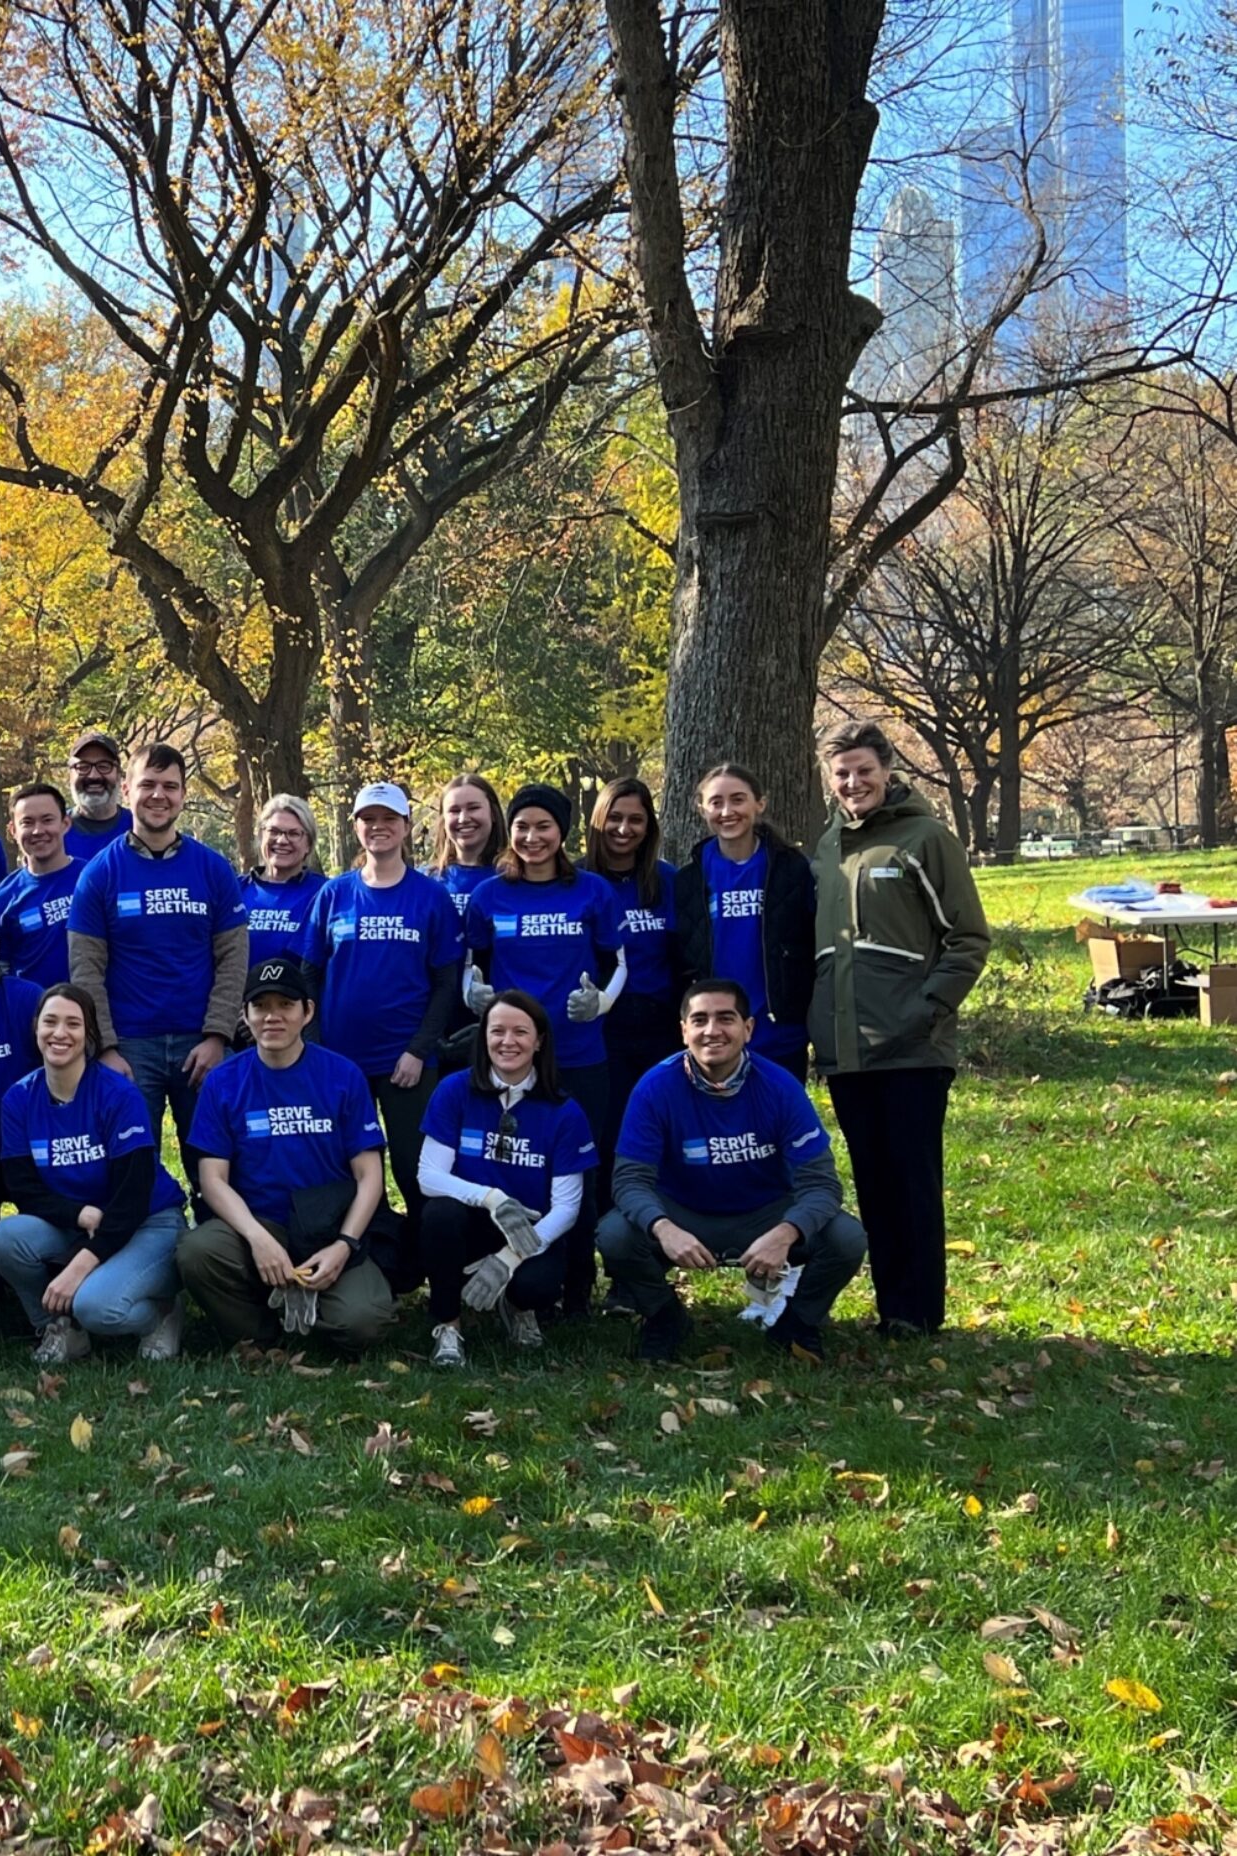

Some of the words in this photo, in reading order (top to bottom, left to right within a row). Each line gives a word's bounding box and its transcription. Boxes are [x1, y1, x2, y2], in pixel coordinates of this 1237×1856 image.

[145, 888, 189, 901] SERVE
[722, 889, 764, 904] SERVE
[43, 895, 73, 914] SERV
[146, 901, 207, 915] 2GETHER
[249, 909, 290, 921] SERVE
[360, 916, 404, 928] SERVE
[521, 913, 567, 925] SERVE
[625, 909, 653, 920] RVE
[629, 918, 665, 933] ETHE
[359, 927, 420, 942] 2GETHER
[268, 1106, 312, 1122] SERVE
[271, 1118, 332, 1136] 2GETHER
[51, 1134, 90, 1152] SERVE
[709, 1132, 756, 1150] SERVE
